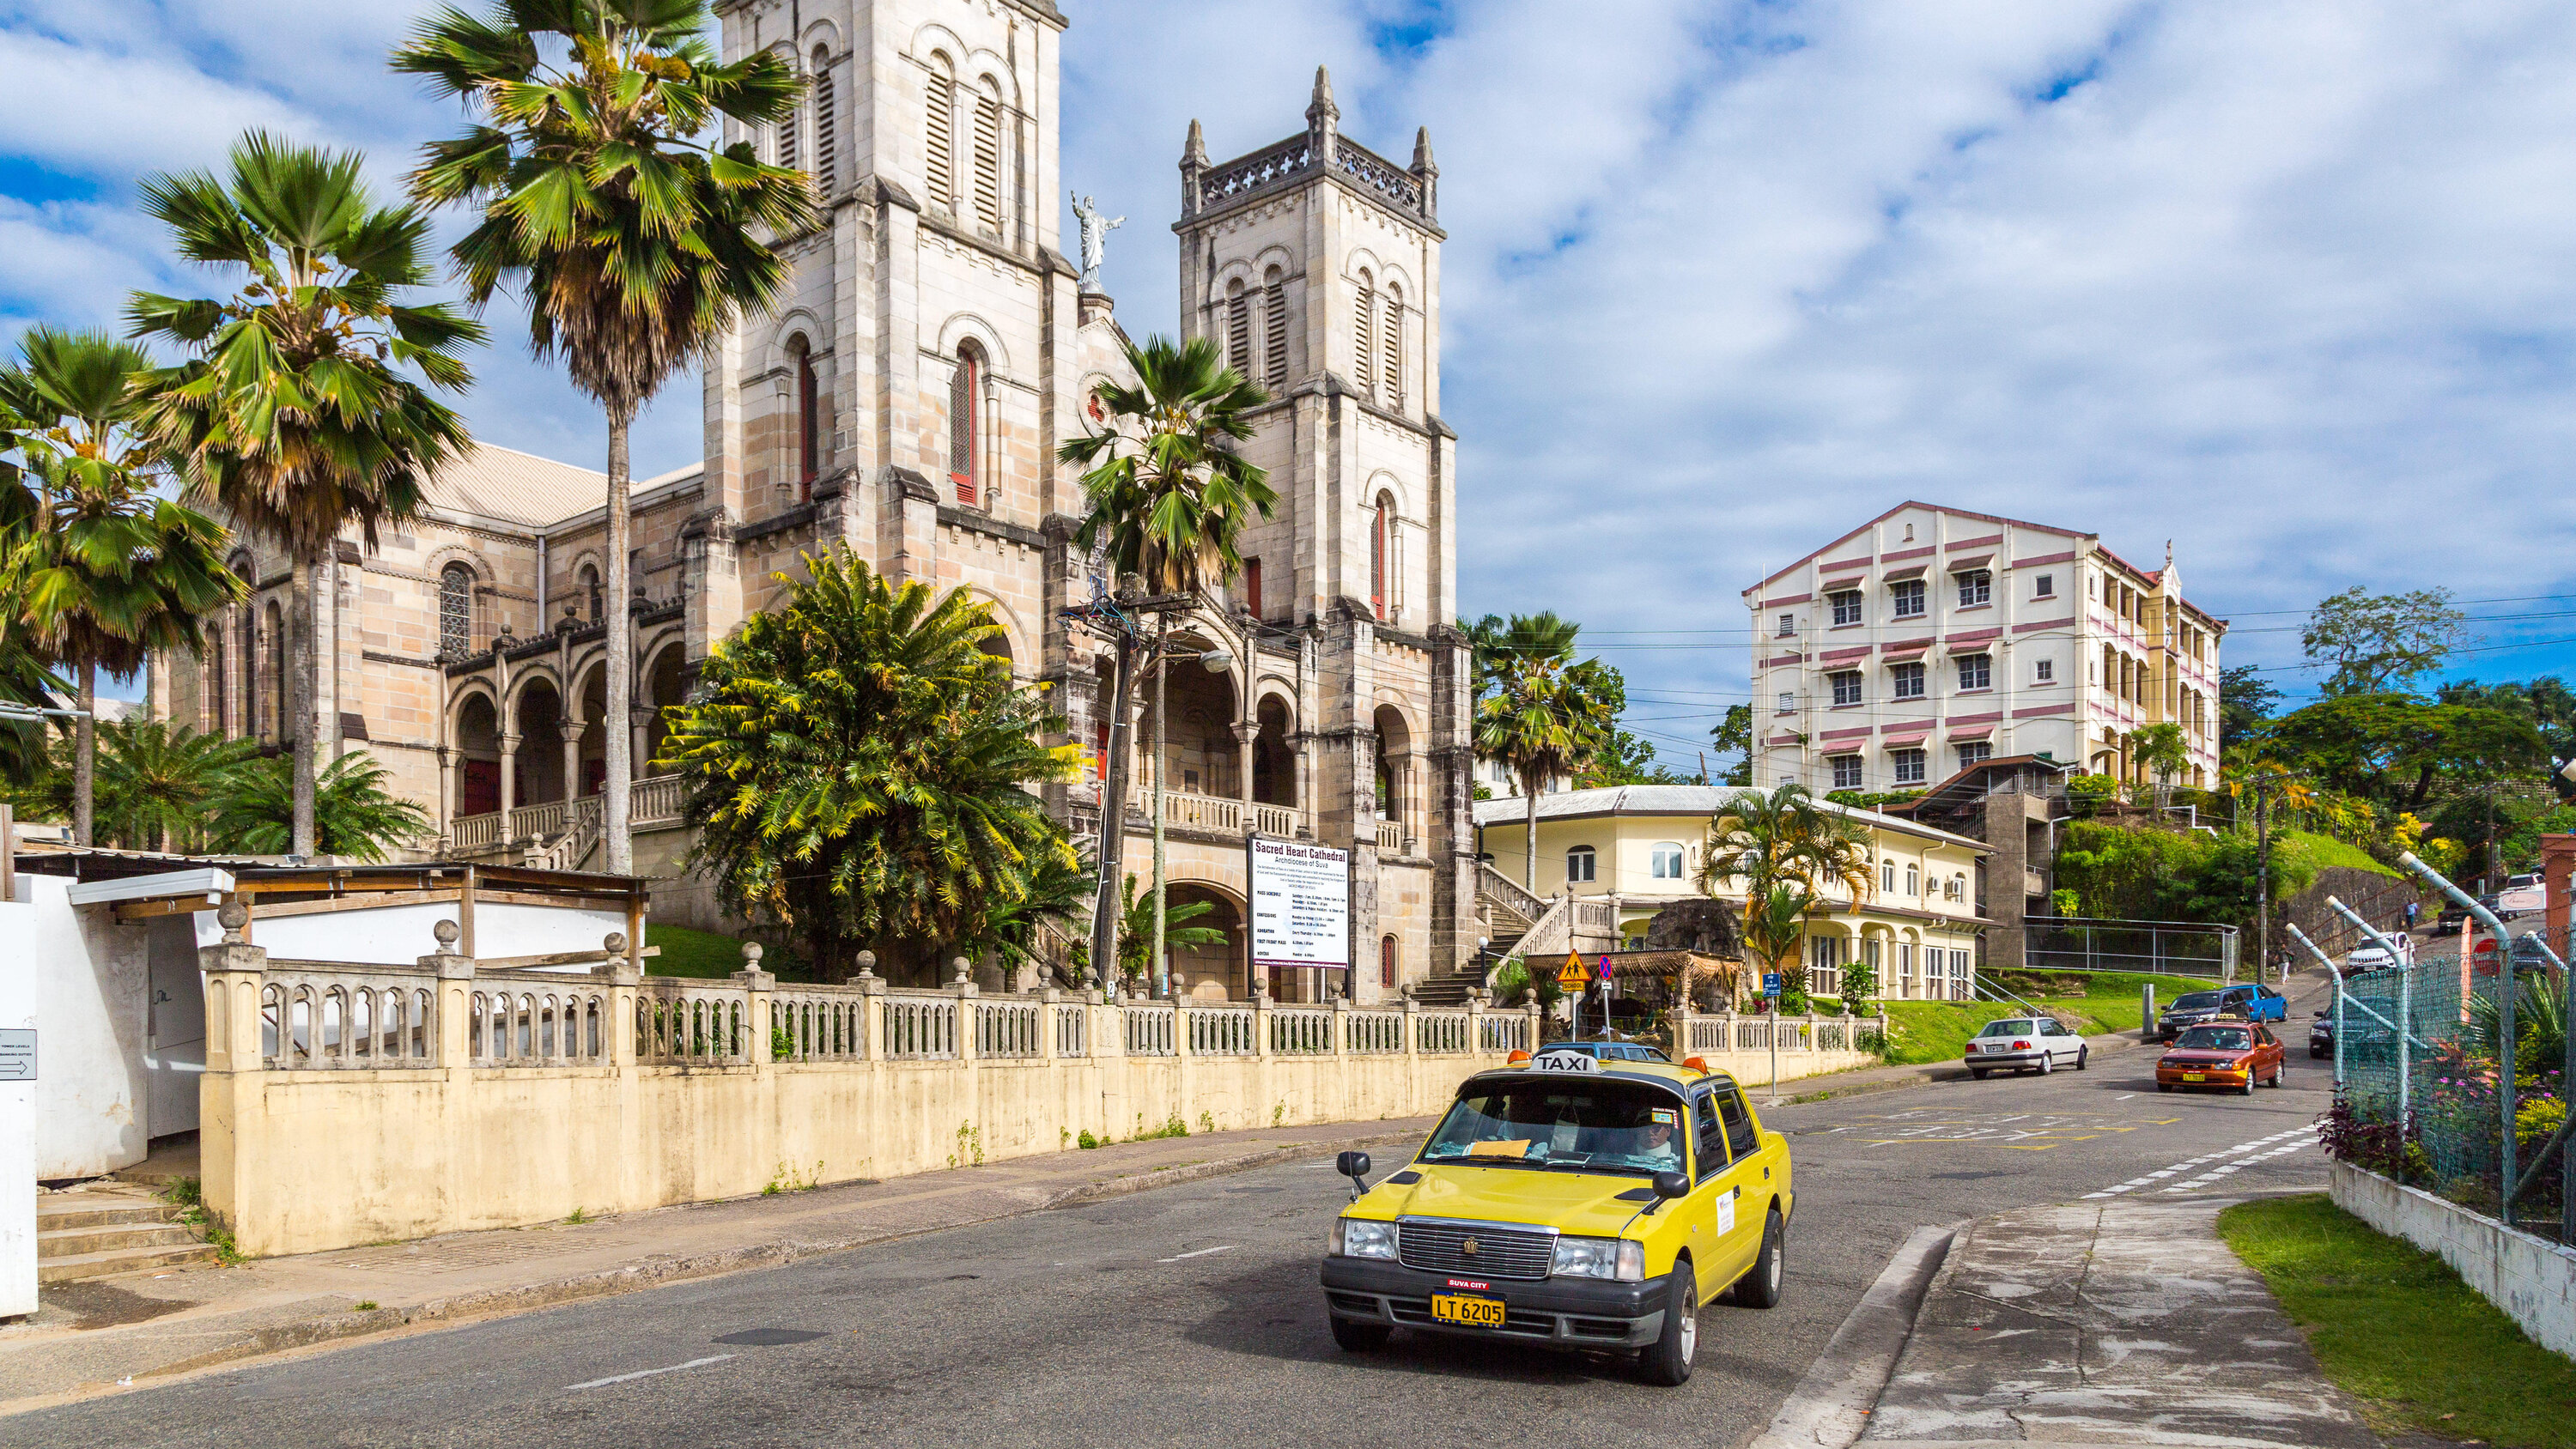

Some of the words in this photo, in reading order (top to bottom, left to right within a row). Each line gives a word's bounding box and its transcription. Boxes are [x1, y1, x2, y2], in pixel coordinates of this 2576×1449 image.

[1255, 841, 1284, 855] Sacred
[1286, 845, 1308, 858] Heart
[1309, 848, 1346, 862] Cathedral
[1274, 856, 1308, 867] Archdiocese
[1315, 860, 1328, 869] Suva
[1538, 1057, 1589, 1071] TAXI
[1449, 1279, 1469, 1288] SUVA
[1437, 1300, 1457, 1319] LT
[1461, 1302, 1502, 1323] 6205
